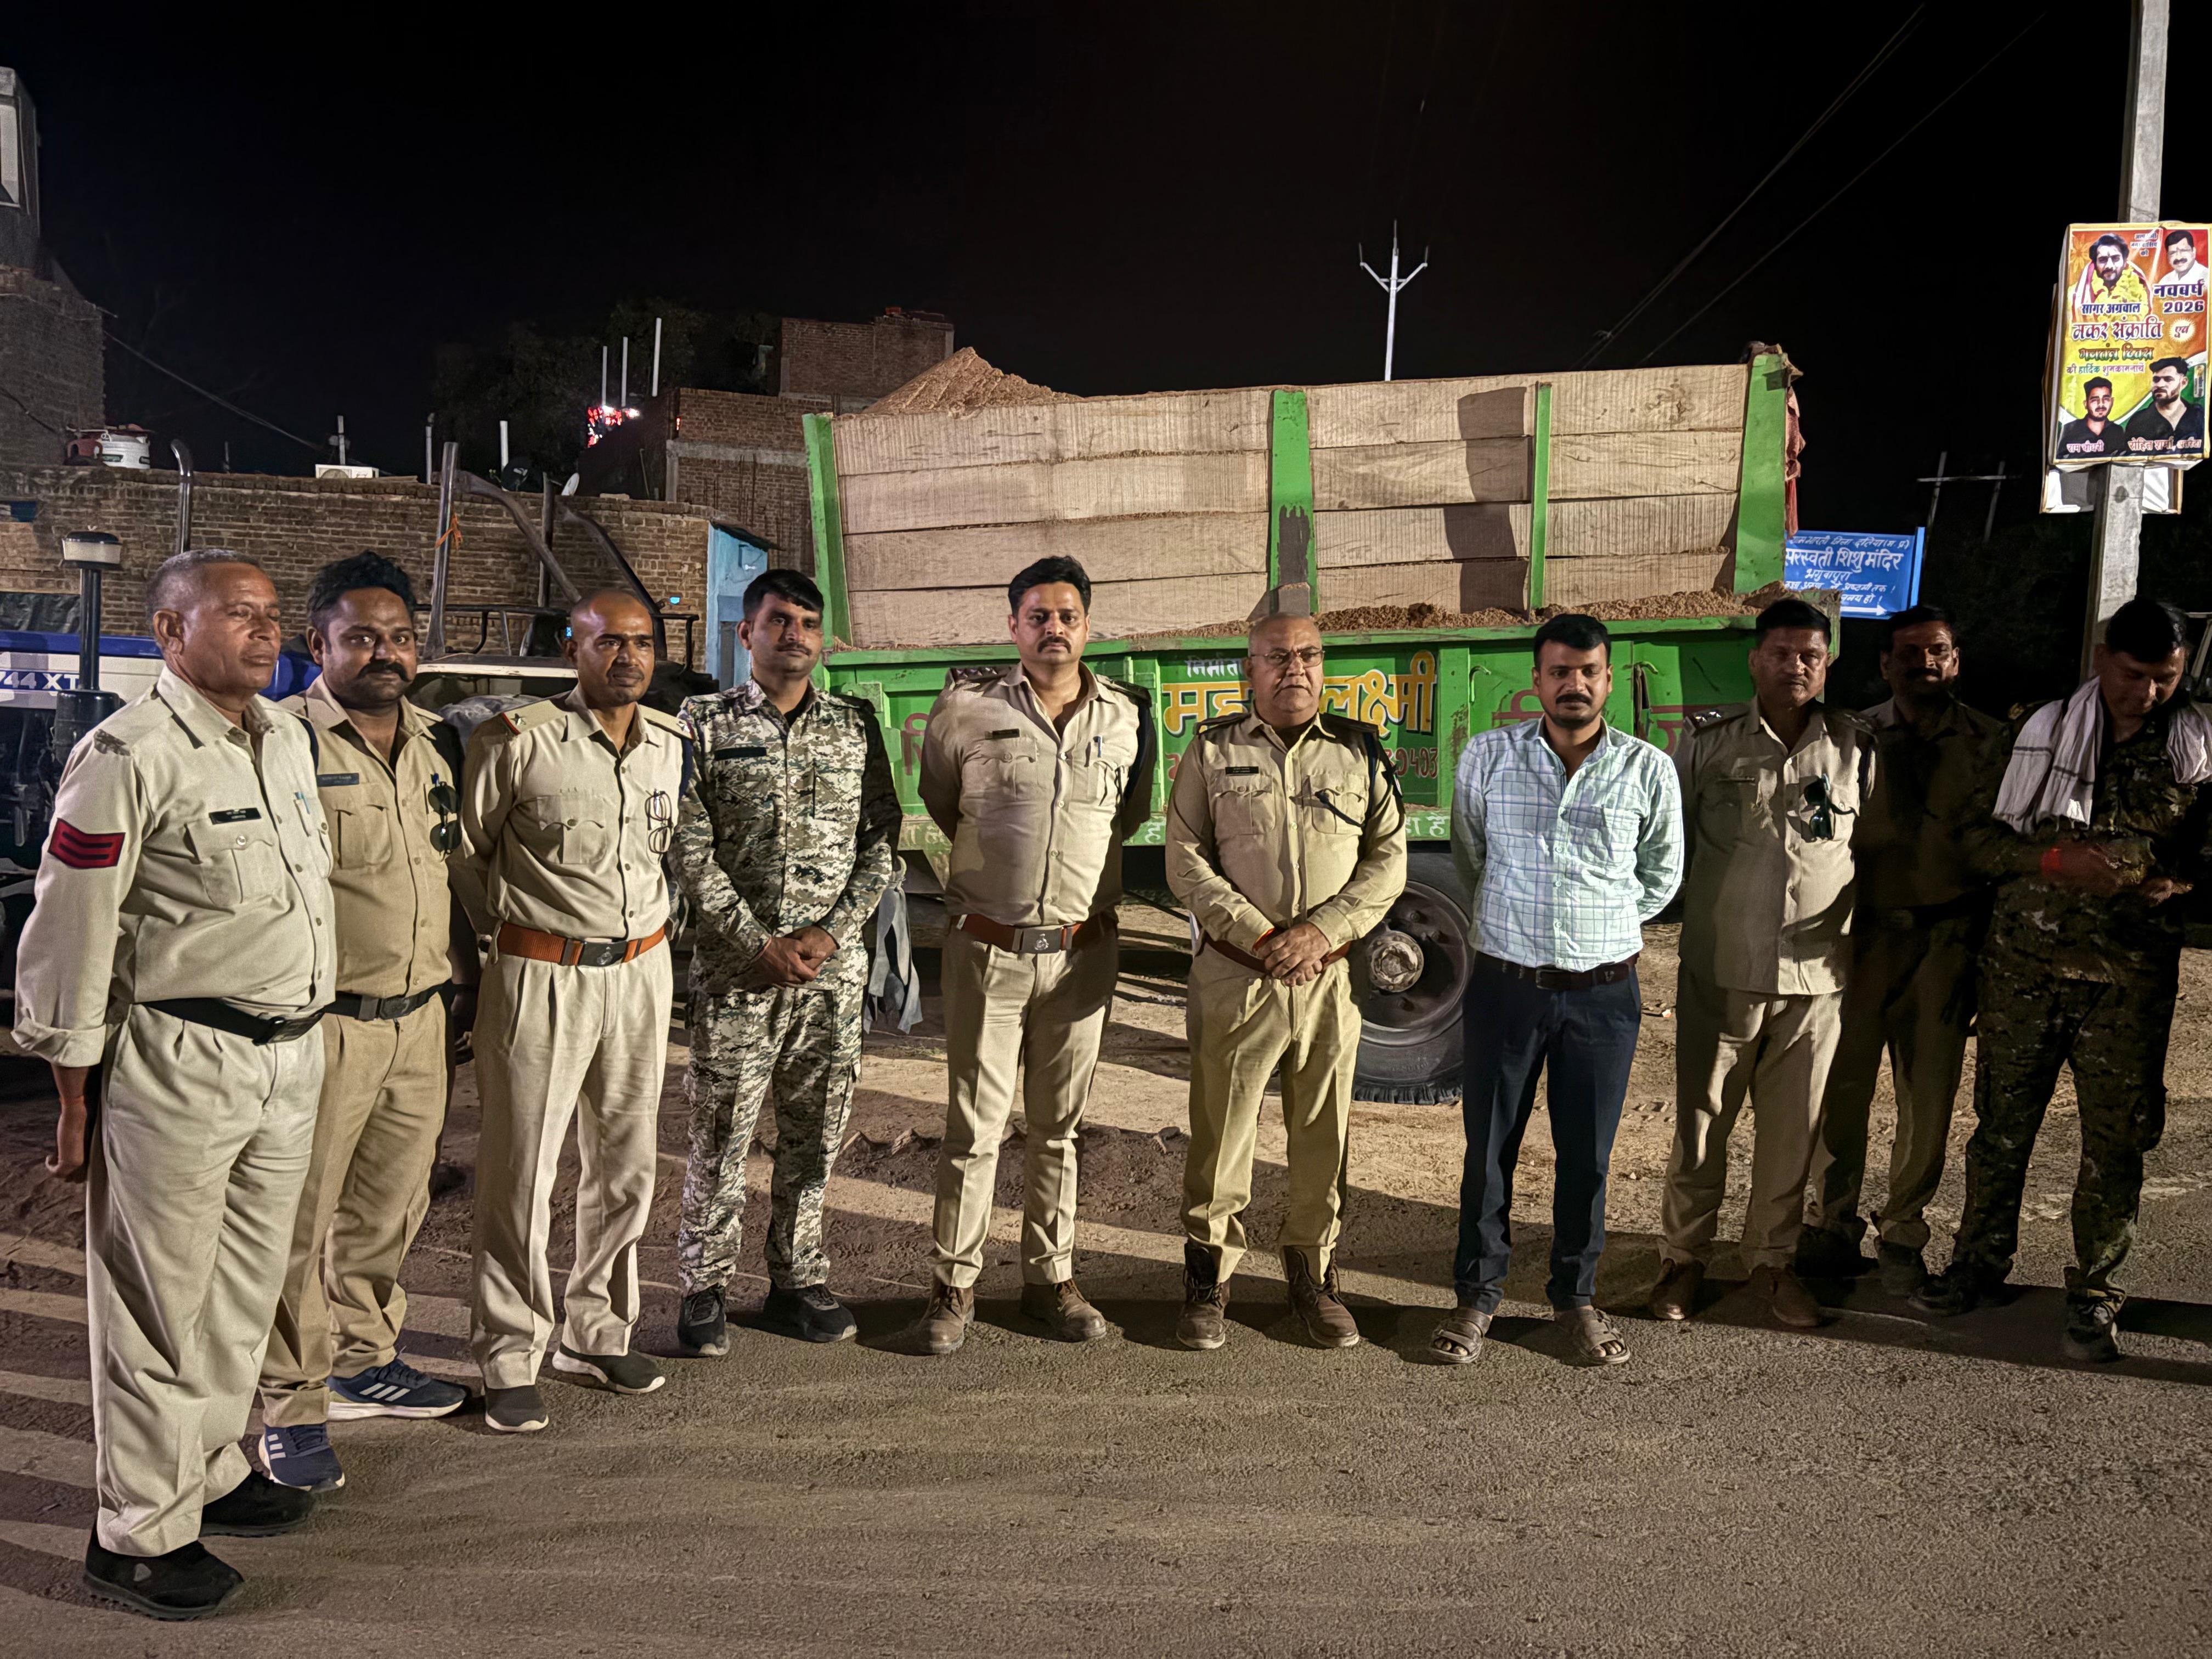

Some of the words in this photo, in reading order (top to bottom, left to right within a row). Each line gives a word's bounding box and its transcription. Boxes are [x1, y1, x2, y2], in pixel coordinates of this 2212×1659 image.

[2153, 279, 2204, 297] नववर्ष
[2082, 303, 2104, 314] सागर
[2106, 302, 2141, 313] अग्रवाल
[2164, 301, 2204, 313] 2026
[2073, 321, 2108, 340] मकर
[2078, 342, 2120, 362] गणतंत्र
[2121, 342, 2155, 361] दिवस
[2066, 364, 2077, 374] की
[2079, 363, 2101, 374] हार्दिक
[2067, 444, 2081, 453] राम
[2128, 437, 2153, 451] रोहित
[1835, 547, 1866, 573] शिशु
[1865, 548, 1904, 571] मंदिर
[1871, 584, 1887, 592] तक
[1863, 592, 1876, 604] हो
[42, 673, 80, 690] XT
